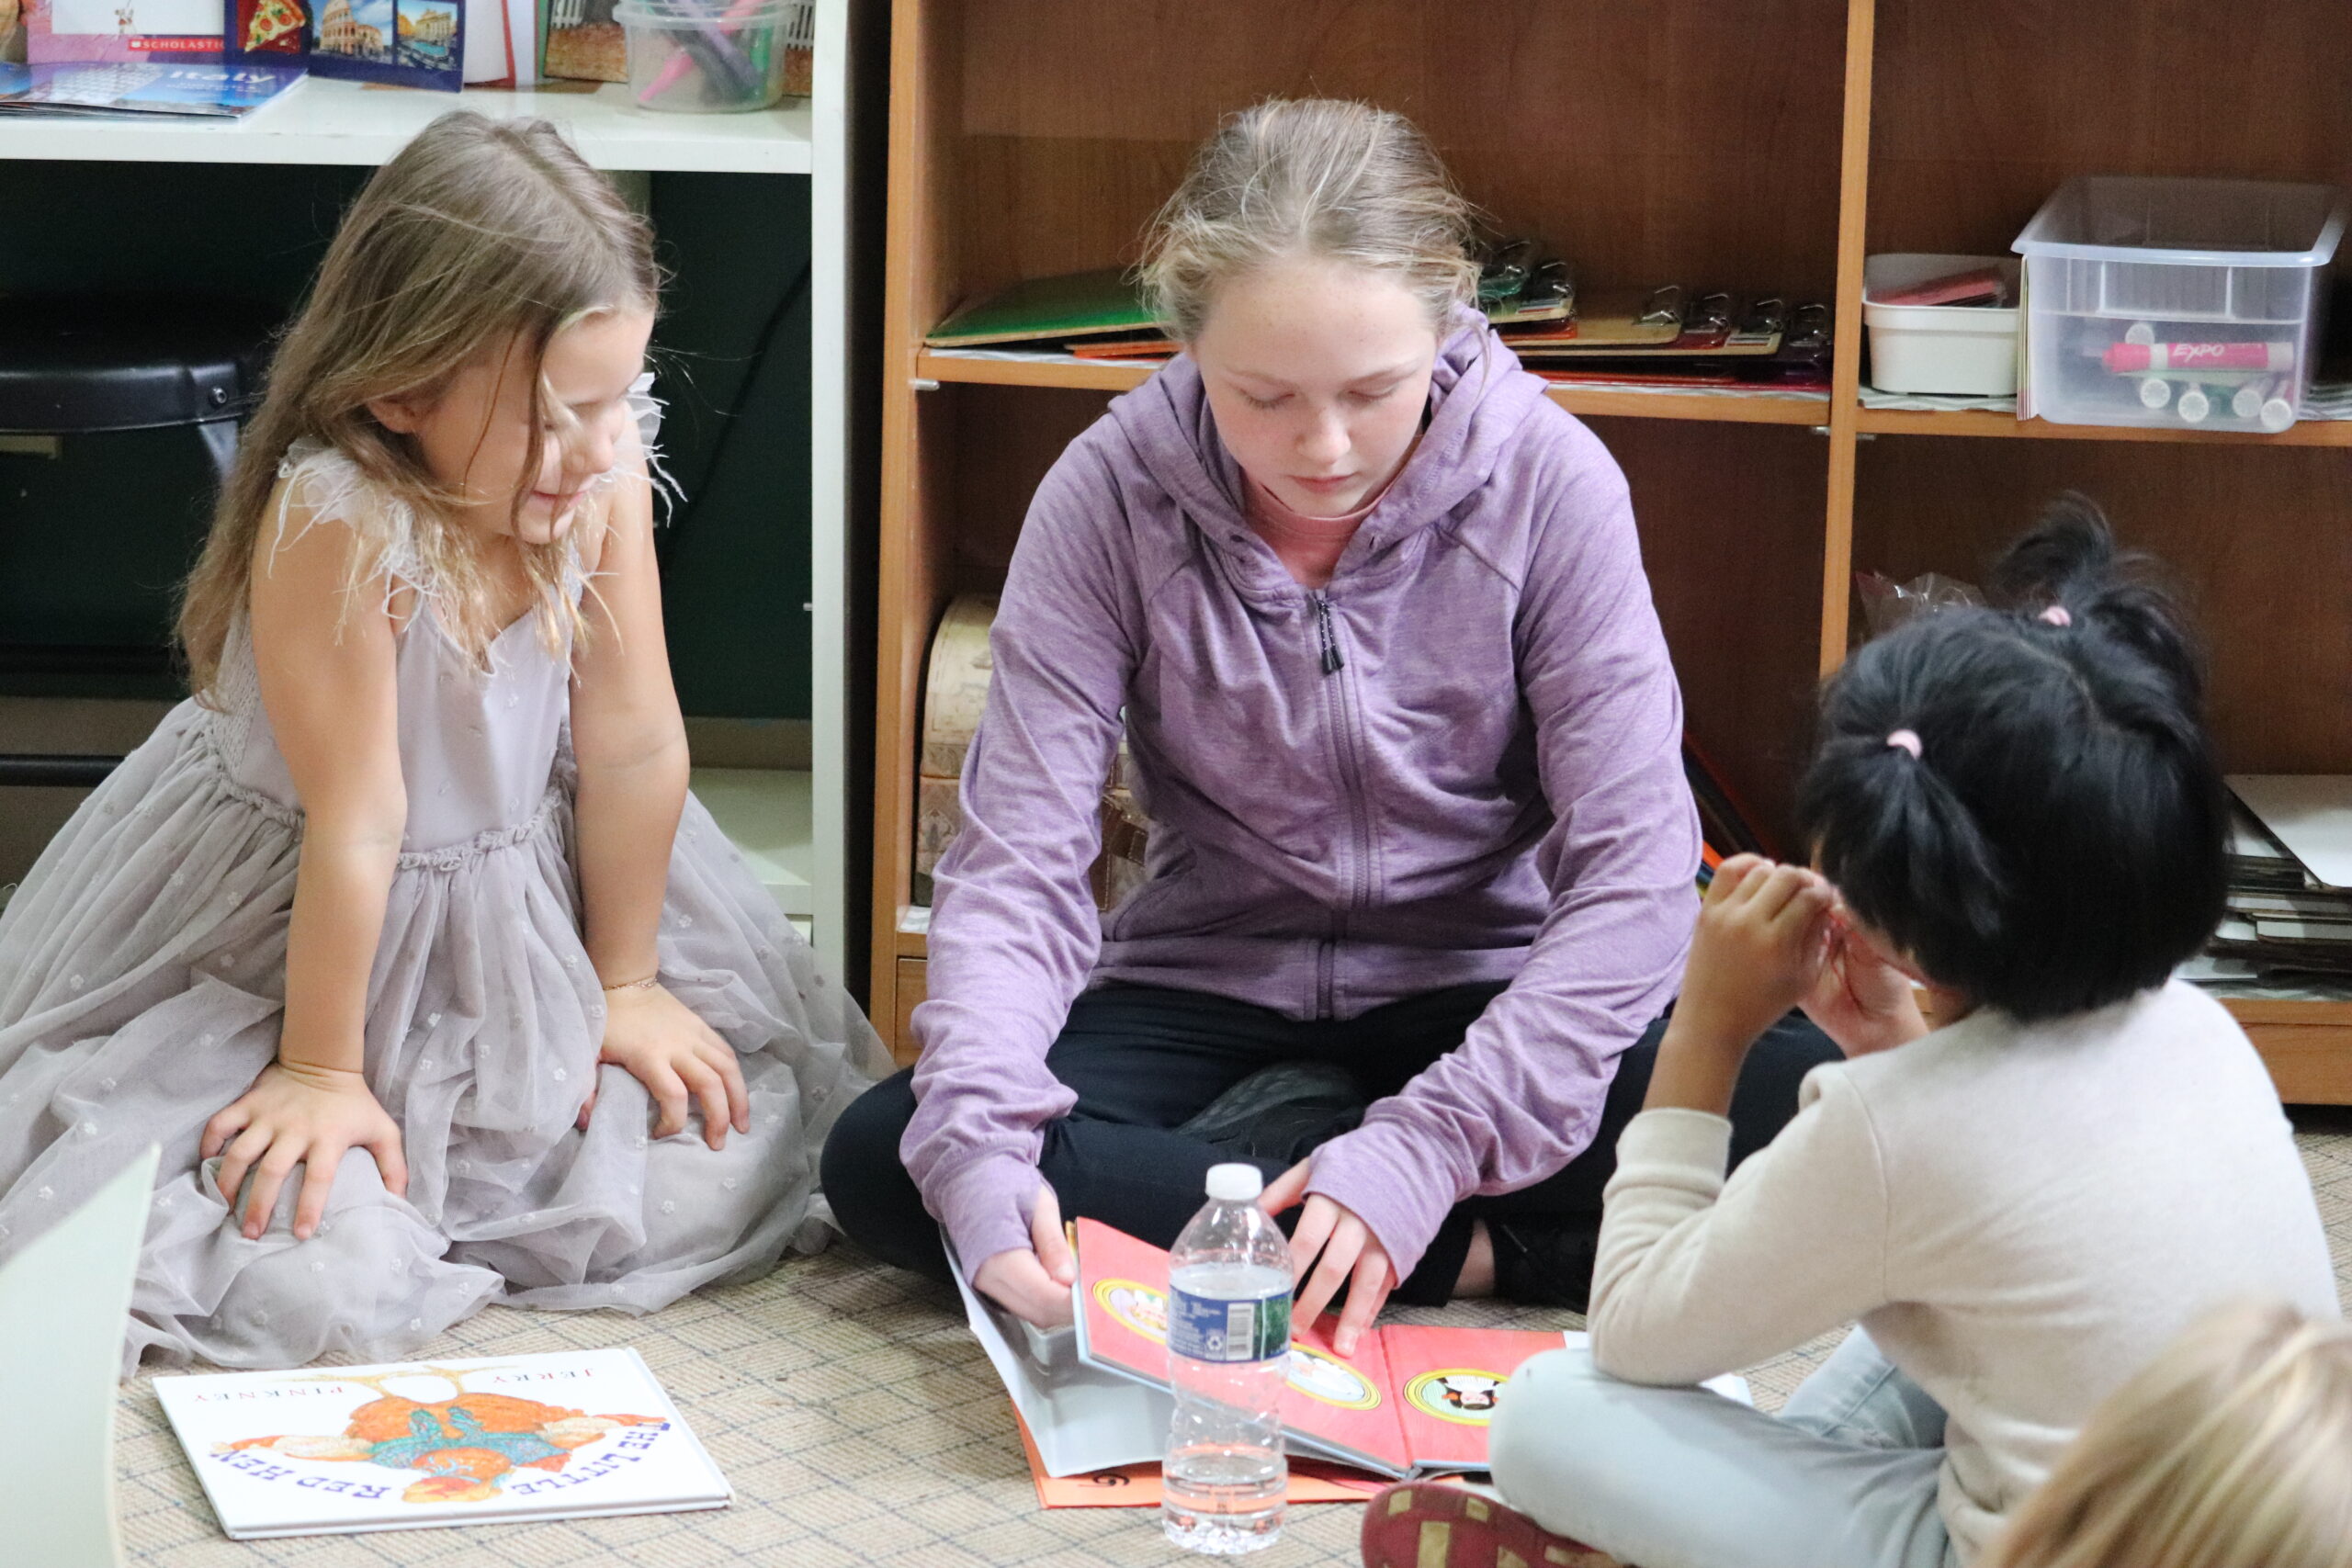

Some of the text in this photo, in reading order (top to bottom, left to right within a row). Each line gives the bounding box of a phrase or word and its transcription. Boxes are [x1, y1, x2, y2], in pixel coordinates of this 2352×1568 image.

[169, 71, 276, 84] Italy
[2172, 344, 2225, 363] EXPO
[195, 1368, 594, 1402] JERRY PINKNEY
[209, 1421, 672, 1499] THE LITTLE RED HEN
